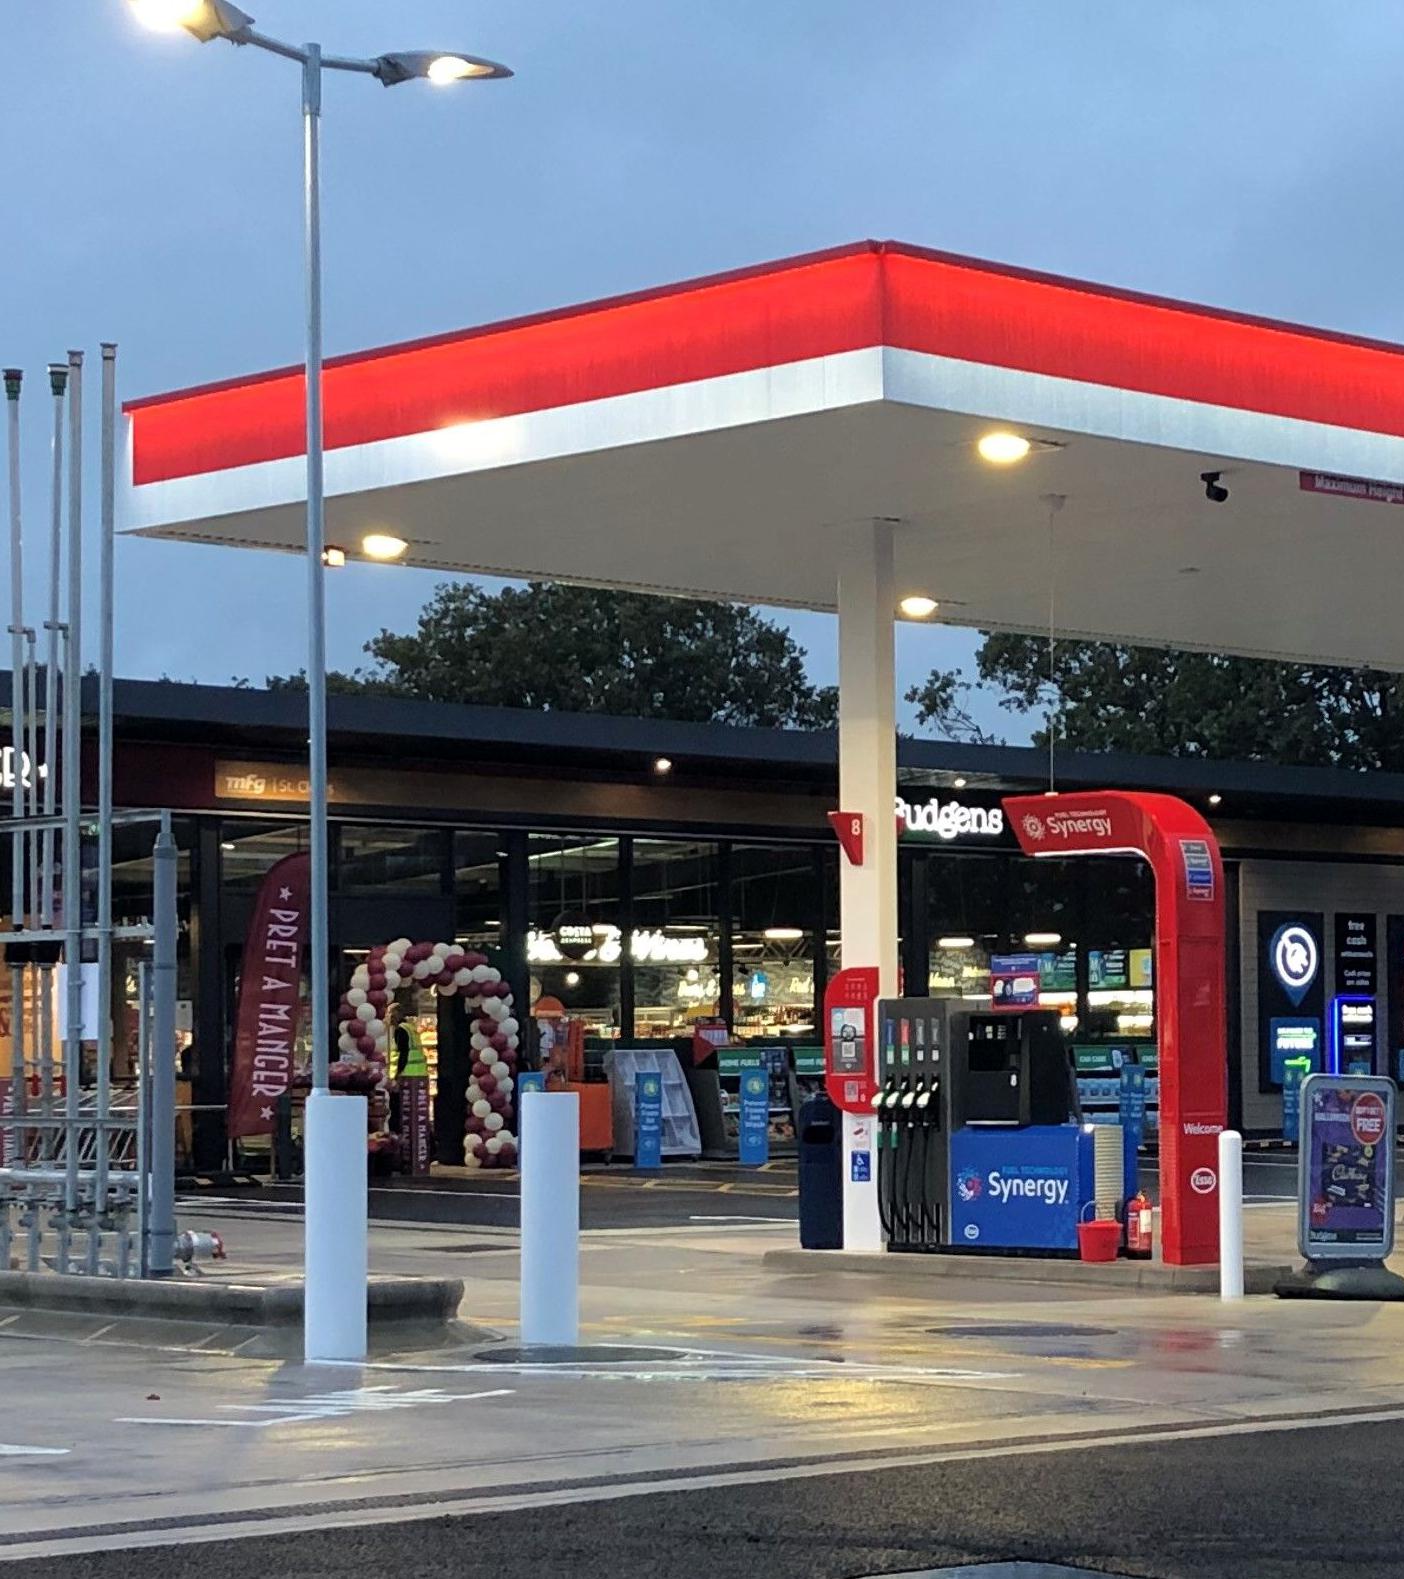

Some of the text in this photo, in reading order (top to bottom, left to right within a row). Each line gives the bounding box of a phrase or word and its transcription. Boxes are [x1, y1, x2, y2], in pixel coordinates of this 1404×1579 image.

[1315, 475, 1367, 494] Maximum
[1368, 482, 1403, 500] Height
[226, 774, 266, 794] mfg
[851, 819, 860, 836] 8
[1046, 816, 1112, 839] Synergy
[559, 926, 593, 937] COSTA
[251, 907, 300, 1098] PRET A MANGER
[1183, 1122, 1223, 1134] Welcome
[1356, 1117, 1381, 1132] FREE
[988, 1171, 1069, 1204] Synergy
